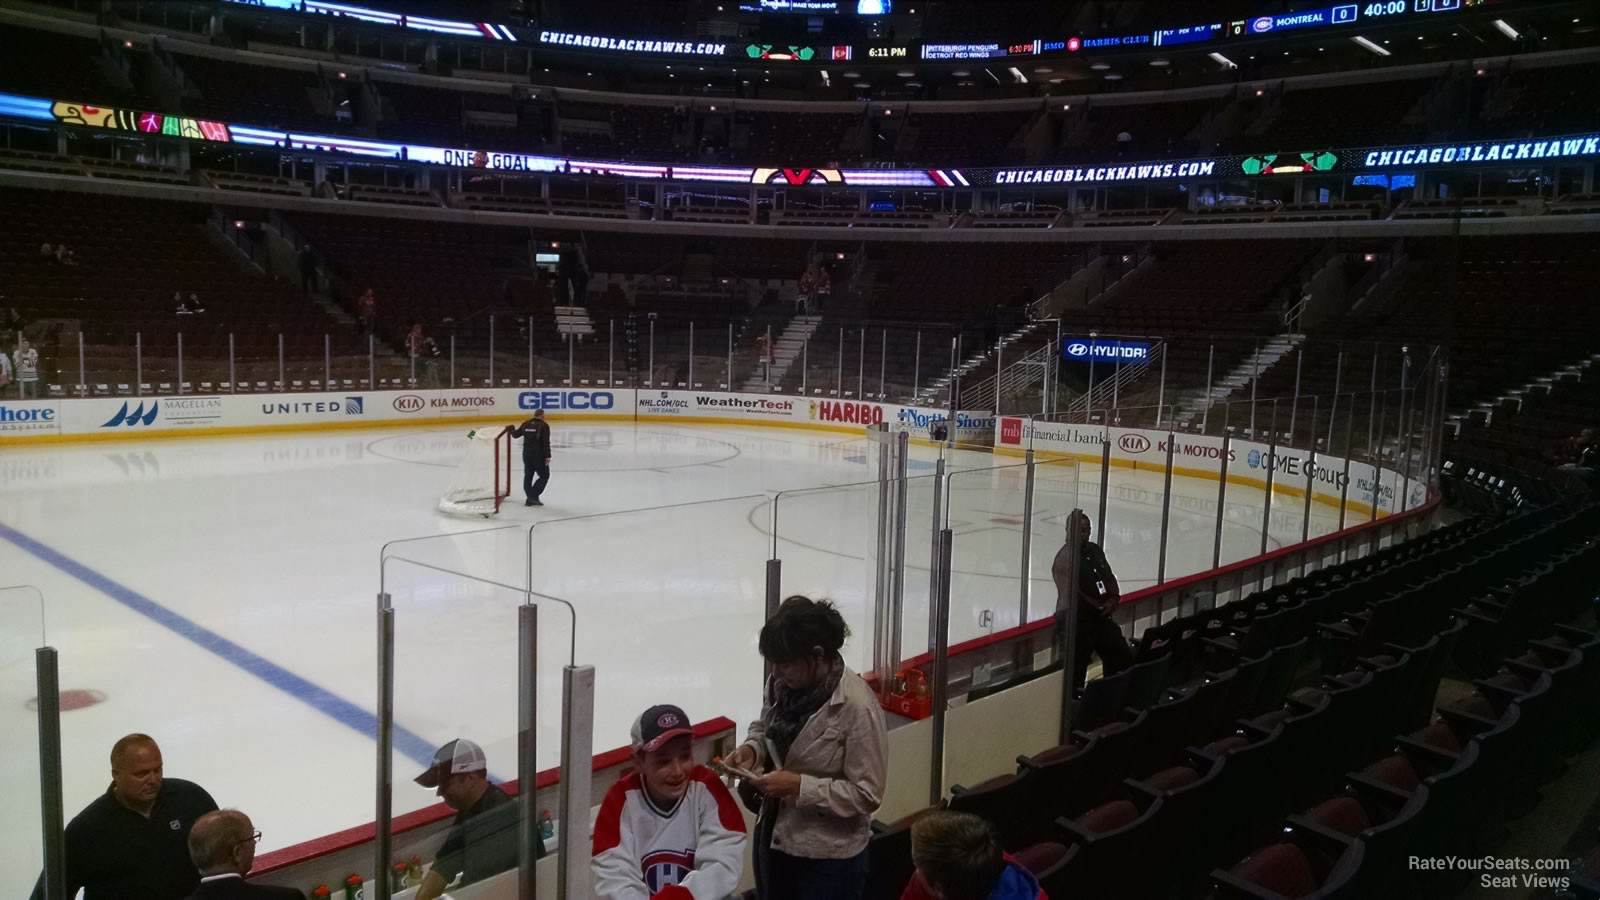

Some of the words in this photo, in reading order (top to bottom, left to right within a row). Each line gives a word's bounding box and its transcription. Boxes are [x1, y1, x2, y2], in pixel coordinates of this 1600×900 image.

[1340, 10, 1348, 20] 0
[1364, 2, 1405, 17] 40:00
[1276, 14, 1324, 27] MONTREAL
[1234, 26, 1241, 34] 0
[540, 31, 726, 55] CHICAGOBLACKHAWKS.COM
[928, 45, 966, 53] PITTSBURGH
[1044, 42, 1065, 50] BMO
[1084, 37, 1120, 47] HARRIS
[1123, 35, 1149, 44] CLUB
[869, 48, 888, 57] 6:11
[890, 47, 906, 57] PM
[1365, 138, 1600, 167] CHICAGOBLACKHAWK
[444, 150, 474, 166] ONE
[493, 154, 530, 170] GOAL
[995, 162, 1215, 184] CHICAGOBLACKHAWKS.COM
[1089, 345, 1147, 358] HYUNDAI
[164, 400, 221, 408] MAGELLAN
[399, 397, 420, 409] KIA
[430, 398, 449, 407] KIA
[451, 396, 495, 407] MOTORS
[518, 391, 614, 410] GEICO
[639, 399, 689, 408] NHL.COM/GCL
[696, 396, 793, 410] WeatherTech
[262, 402, 340, 414] UNITED
[820, 401, 883, 424] HARIBO
[907, 408, 944, 427] North
[1074, 429, 1106, 445] bank
[1122, 437, 1144, 450] KIA
[1303, 460, 1350, 491] Group
